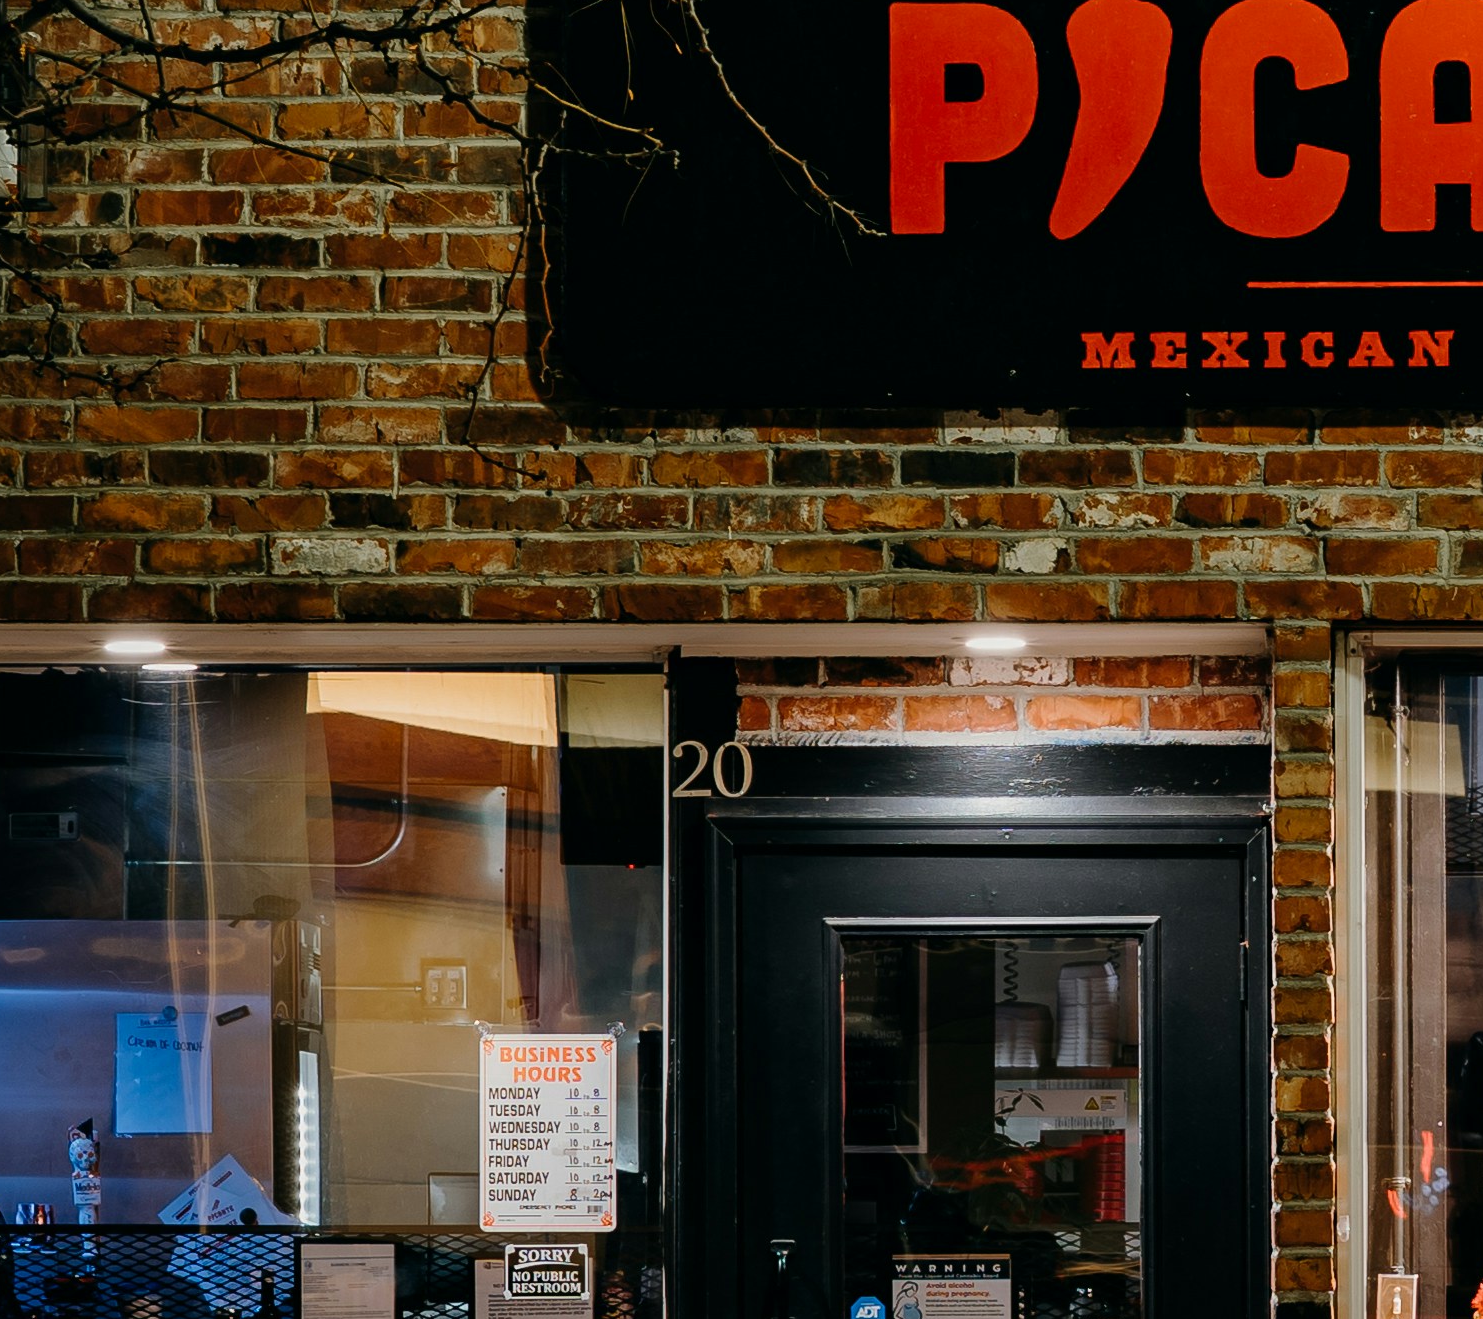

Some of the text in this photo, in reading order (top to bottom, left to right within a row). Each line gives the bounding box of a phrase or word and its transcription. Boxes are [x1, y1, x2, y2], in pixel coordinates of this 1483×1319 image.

[1081, 330, 1456, 370] MEXICAN
[673, 740, 753, 798] 20
[160, 1040, 169, 1050] OF
[513, 1066, 581, 1083] HOURS
[489, 1087, 540, 1099] MONDAY
[570, 1088, 579, 1098] 10
[594, 1089, 599, 1097] 8
[489, 1105, 541, 1116] TUESDAY
[570, 1106, 578, 1114] 10
[594, 1105, 599, 1114] 8
[489, 1122, 561, 1133] WEDNESDAY
[570, 1122, 579, 1131] 10
[594, 1122, 599, 1131] 8
[489, 1139, 550, 1150] THURSDAY
[570, 1139, 578, 1147] 10
[489, 1155, 529, 1167] FRIDAY
[570, 1156, 578, 1164] 10
[489, 1172, 549, 1184] SATURDAY
[570, 1173, 578, 1181] 10
[75, 1183, 100, 1191] Modelo
[489, 1189, 536, 1201] SUNDAY
[570, 1189, 578, 1201] 8
[518, 1249, 574, 1263] SORRY
[895, 1264, 1001, 1273] WARNING
[512, 1271, 578, 1282] NO PUBLIC
[512, 1283, 581, 1293] RESTROOM
[856, 1306, 881, 1318] ADT
